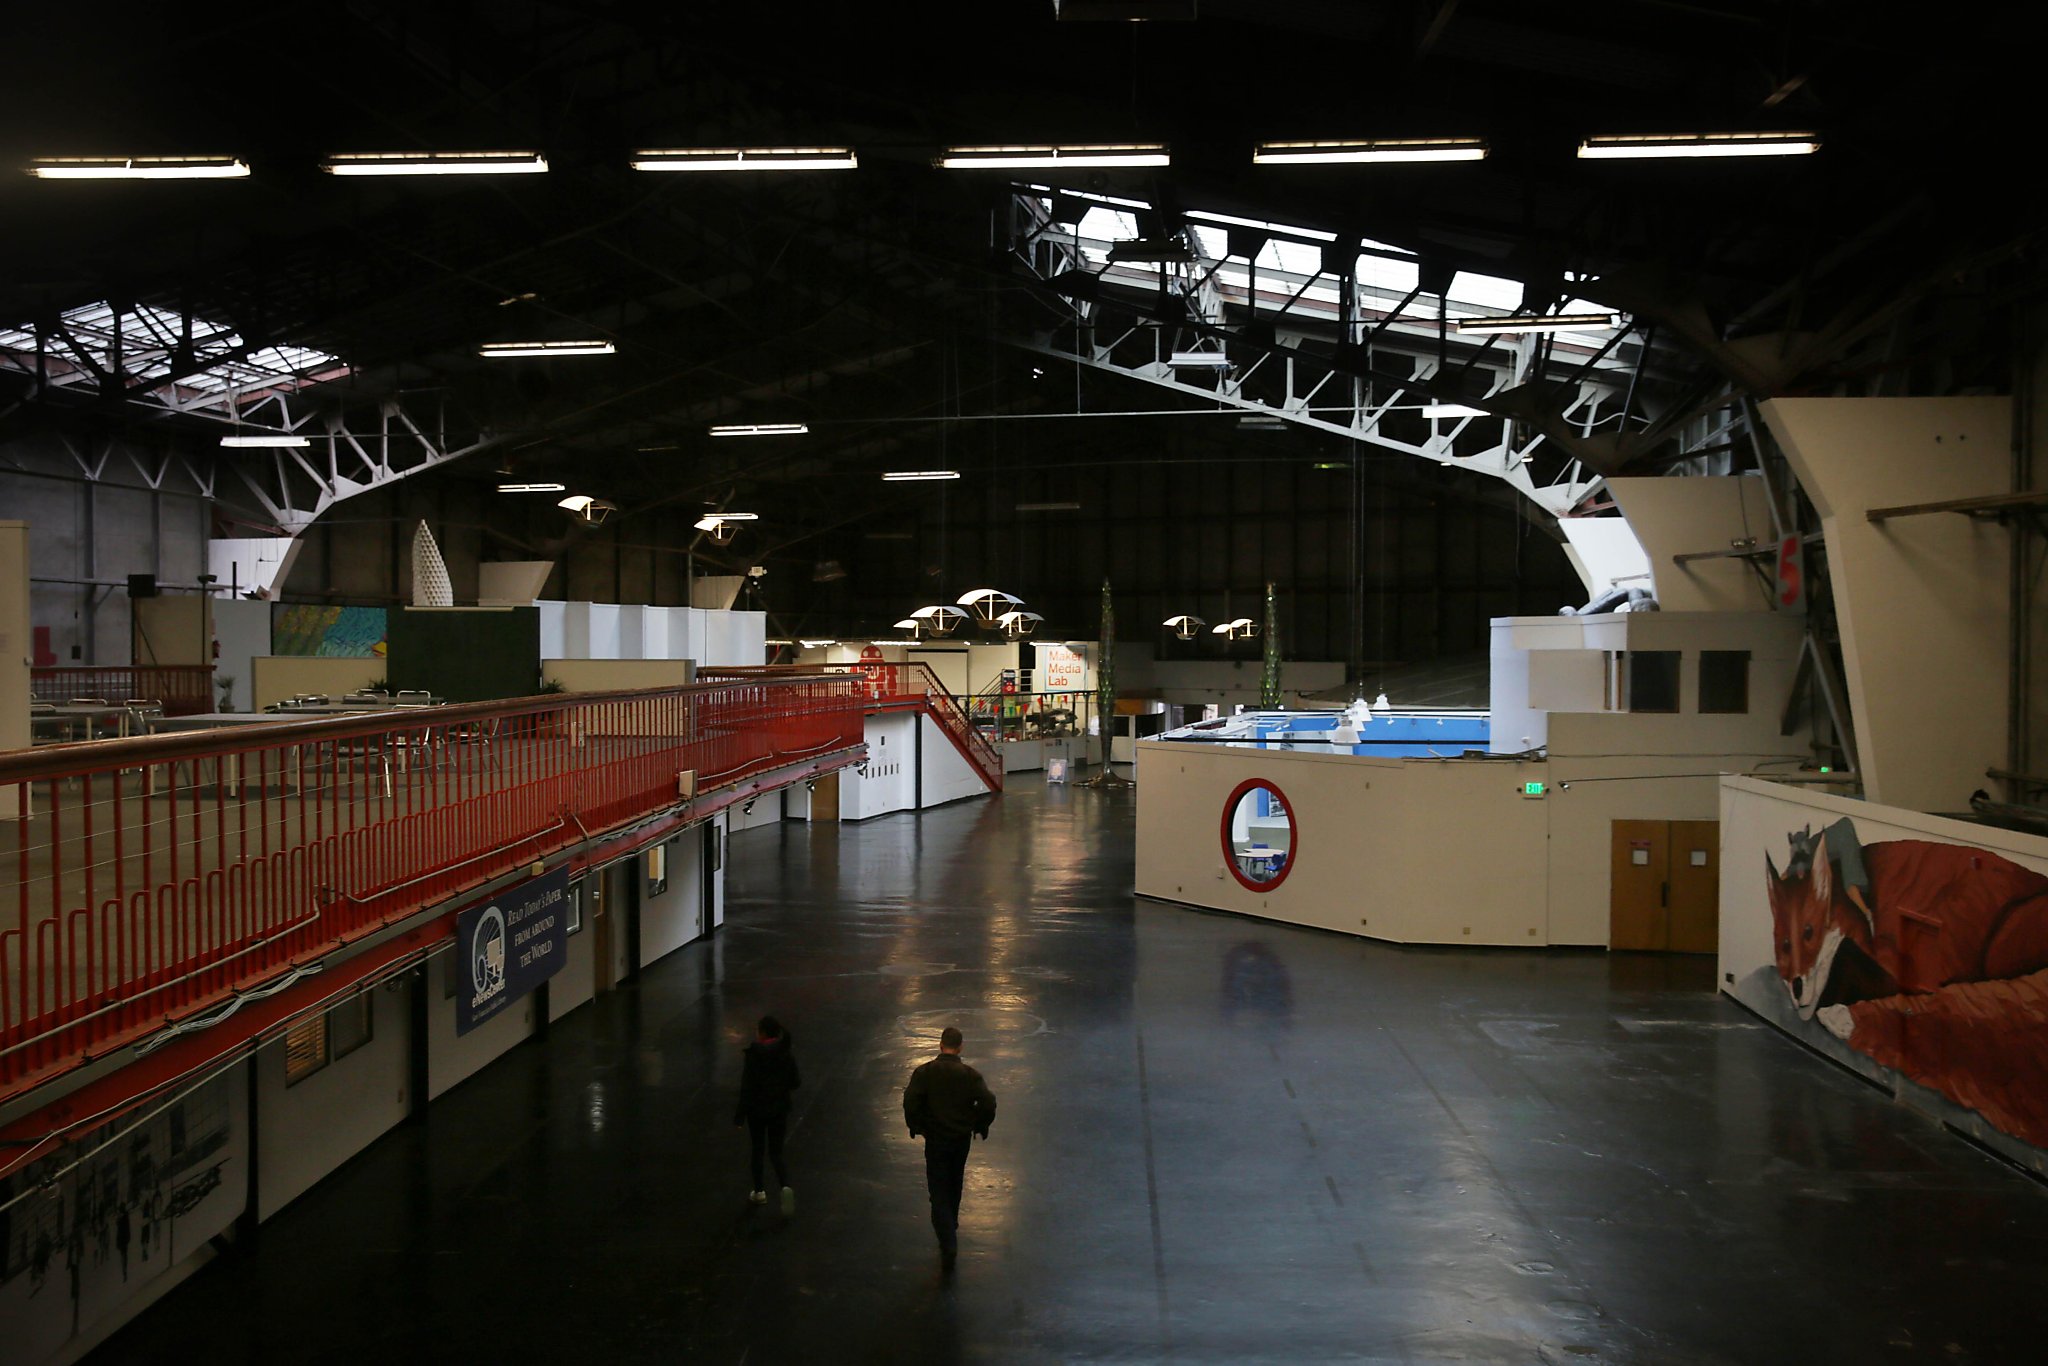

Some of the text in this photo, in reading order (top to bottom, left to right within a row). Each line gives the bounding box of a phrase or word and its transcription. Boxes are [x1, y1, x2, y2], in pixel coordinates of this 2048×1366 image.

[1779, 536, 1800, 606] 5
[1049, 650, 1082, 661] Maker
[1048, 663, 1081, 674] Media
[1048, 676, 1068, 686] Lab
[545, 888, 562, 907] PAPER
[514, 915, 555, 947] FROM AROUND
[520, 940, 553, 968] THE WORLD
